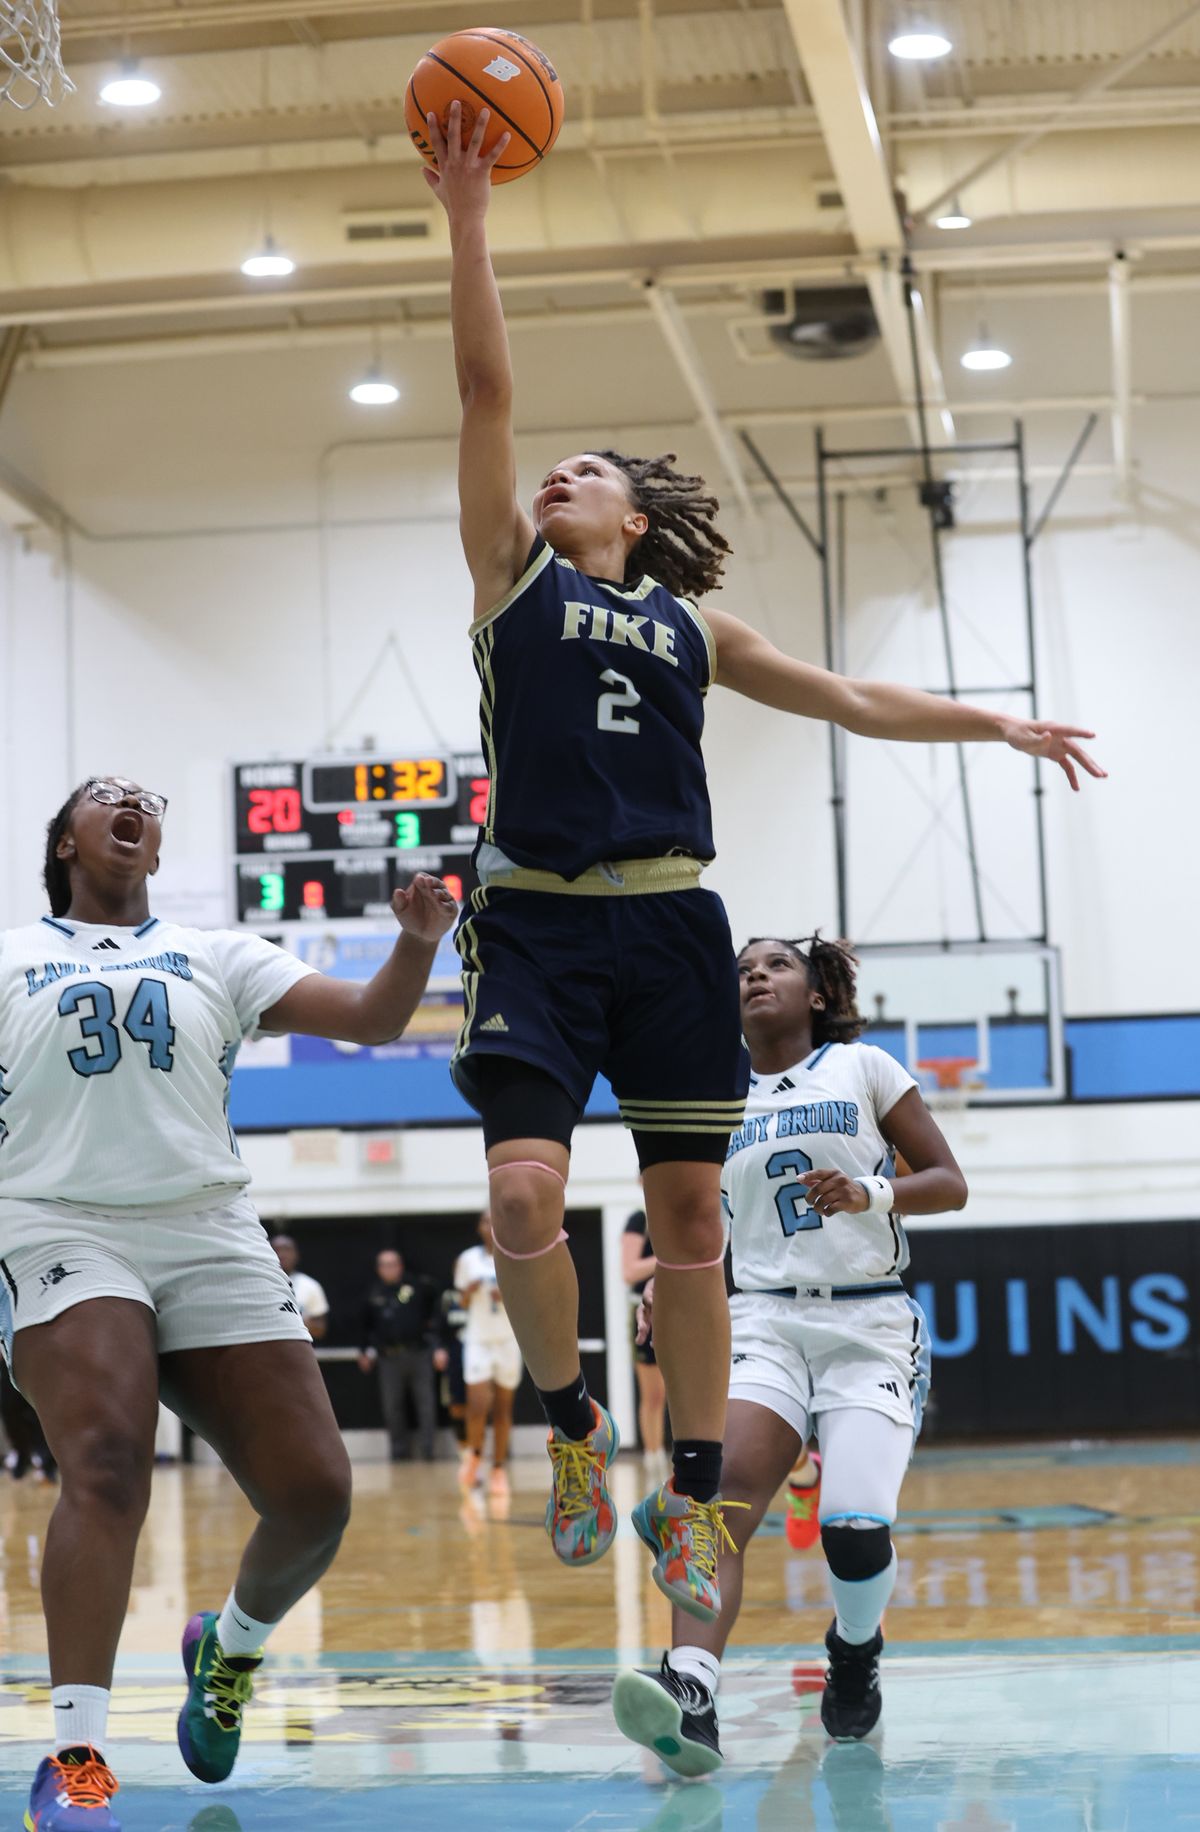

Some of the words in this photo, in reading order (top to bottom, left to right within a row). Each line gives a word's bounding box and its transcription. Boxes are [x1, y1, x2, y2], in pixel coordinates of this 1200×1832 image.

[560, 601, 679, 667] FIKE
[597, 668, 641, 735] 2
[354, 758, 444, 801] 1:32
[248, 788, 301, 834] 20
[395, 812, 420, 849] 3
[259, 873, 284, 911] 3
[57, 977, 176, 1078] 34
[776, 1101, 859, 1139] BRUINS
[765, 1149, 823, 1237] 2
